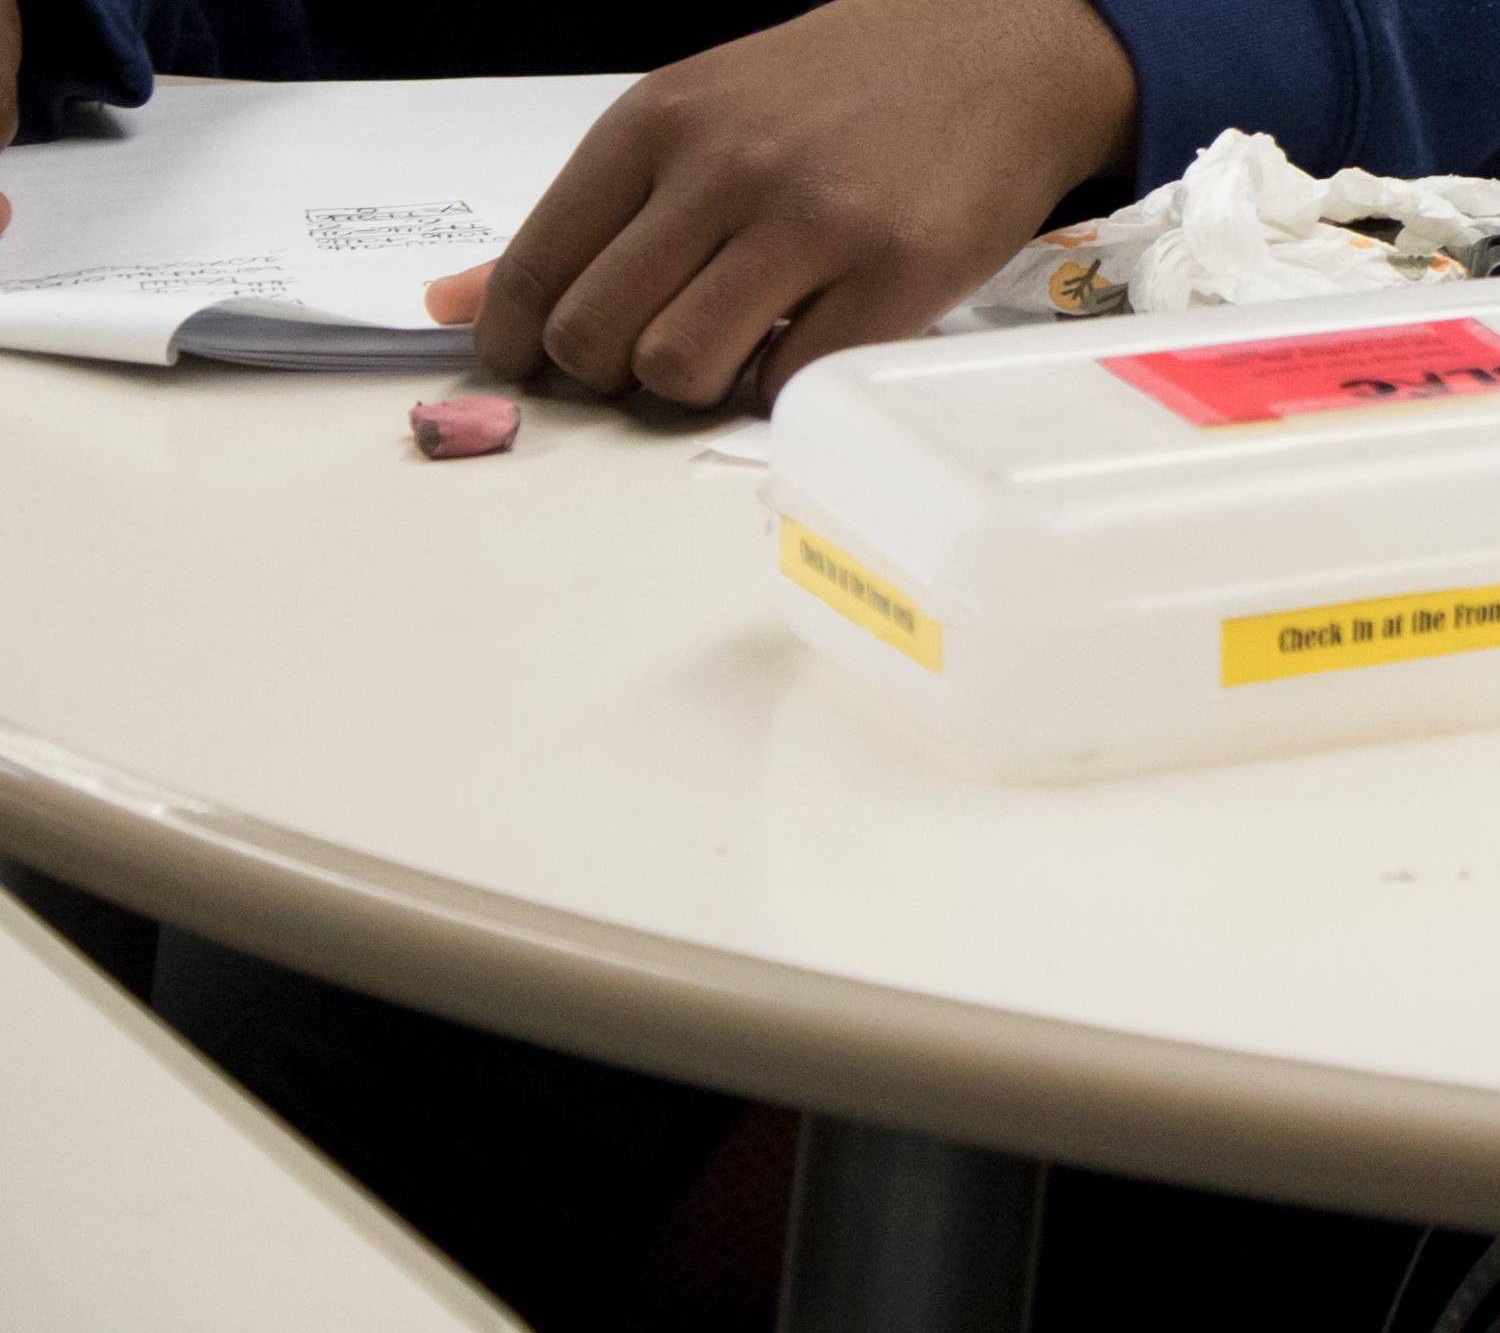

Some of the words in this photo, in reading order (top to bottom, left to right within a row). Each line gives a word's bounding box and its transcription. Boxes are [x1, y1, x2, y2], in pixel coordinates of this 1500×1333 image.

[1279, 621, 1341, 653] Check
[1382, 614, 1402, 639] at
[1411, 609, 1445, 635] the
